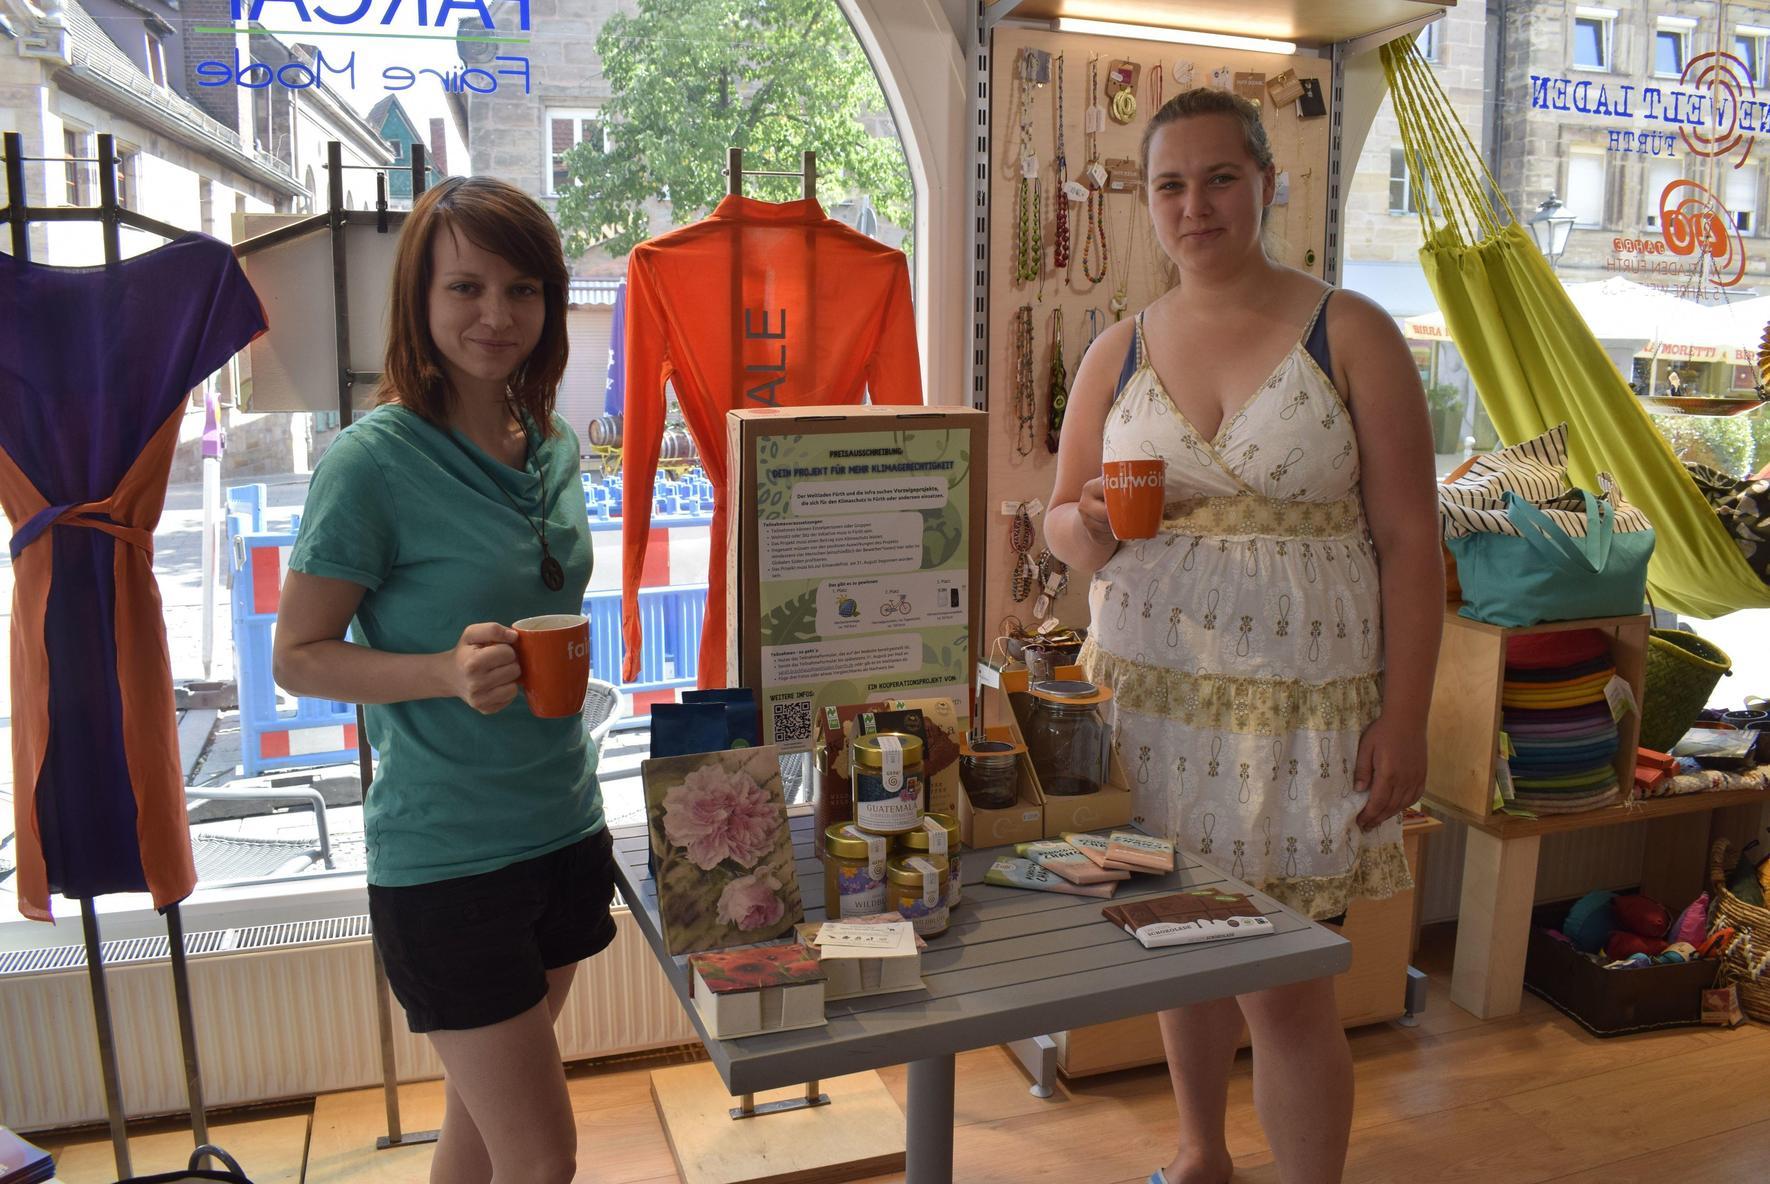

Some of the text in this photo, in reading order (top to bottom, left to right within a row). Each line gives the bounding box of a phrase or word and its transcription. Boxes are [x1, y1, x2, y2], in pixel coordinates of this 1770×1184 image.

[745, 308, 786, 408] ALE
[1661, 343, 1717, 358] MORETTI
[772, 460, 954, 478] DEIN PROJEKT FÜR MEHR KLIMAGERECHTIGKEIT
[879, 677, 943, 689] KOOPERATIONSPROJEKT
[770, 692, 794, 701] WEITERE
